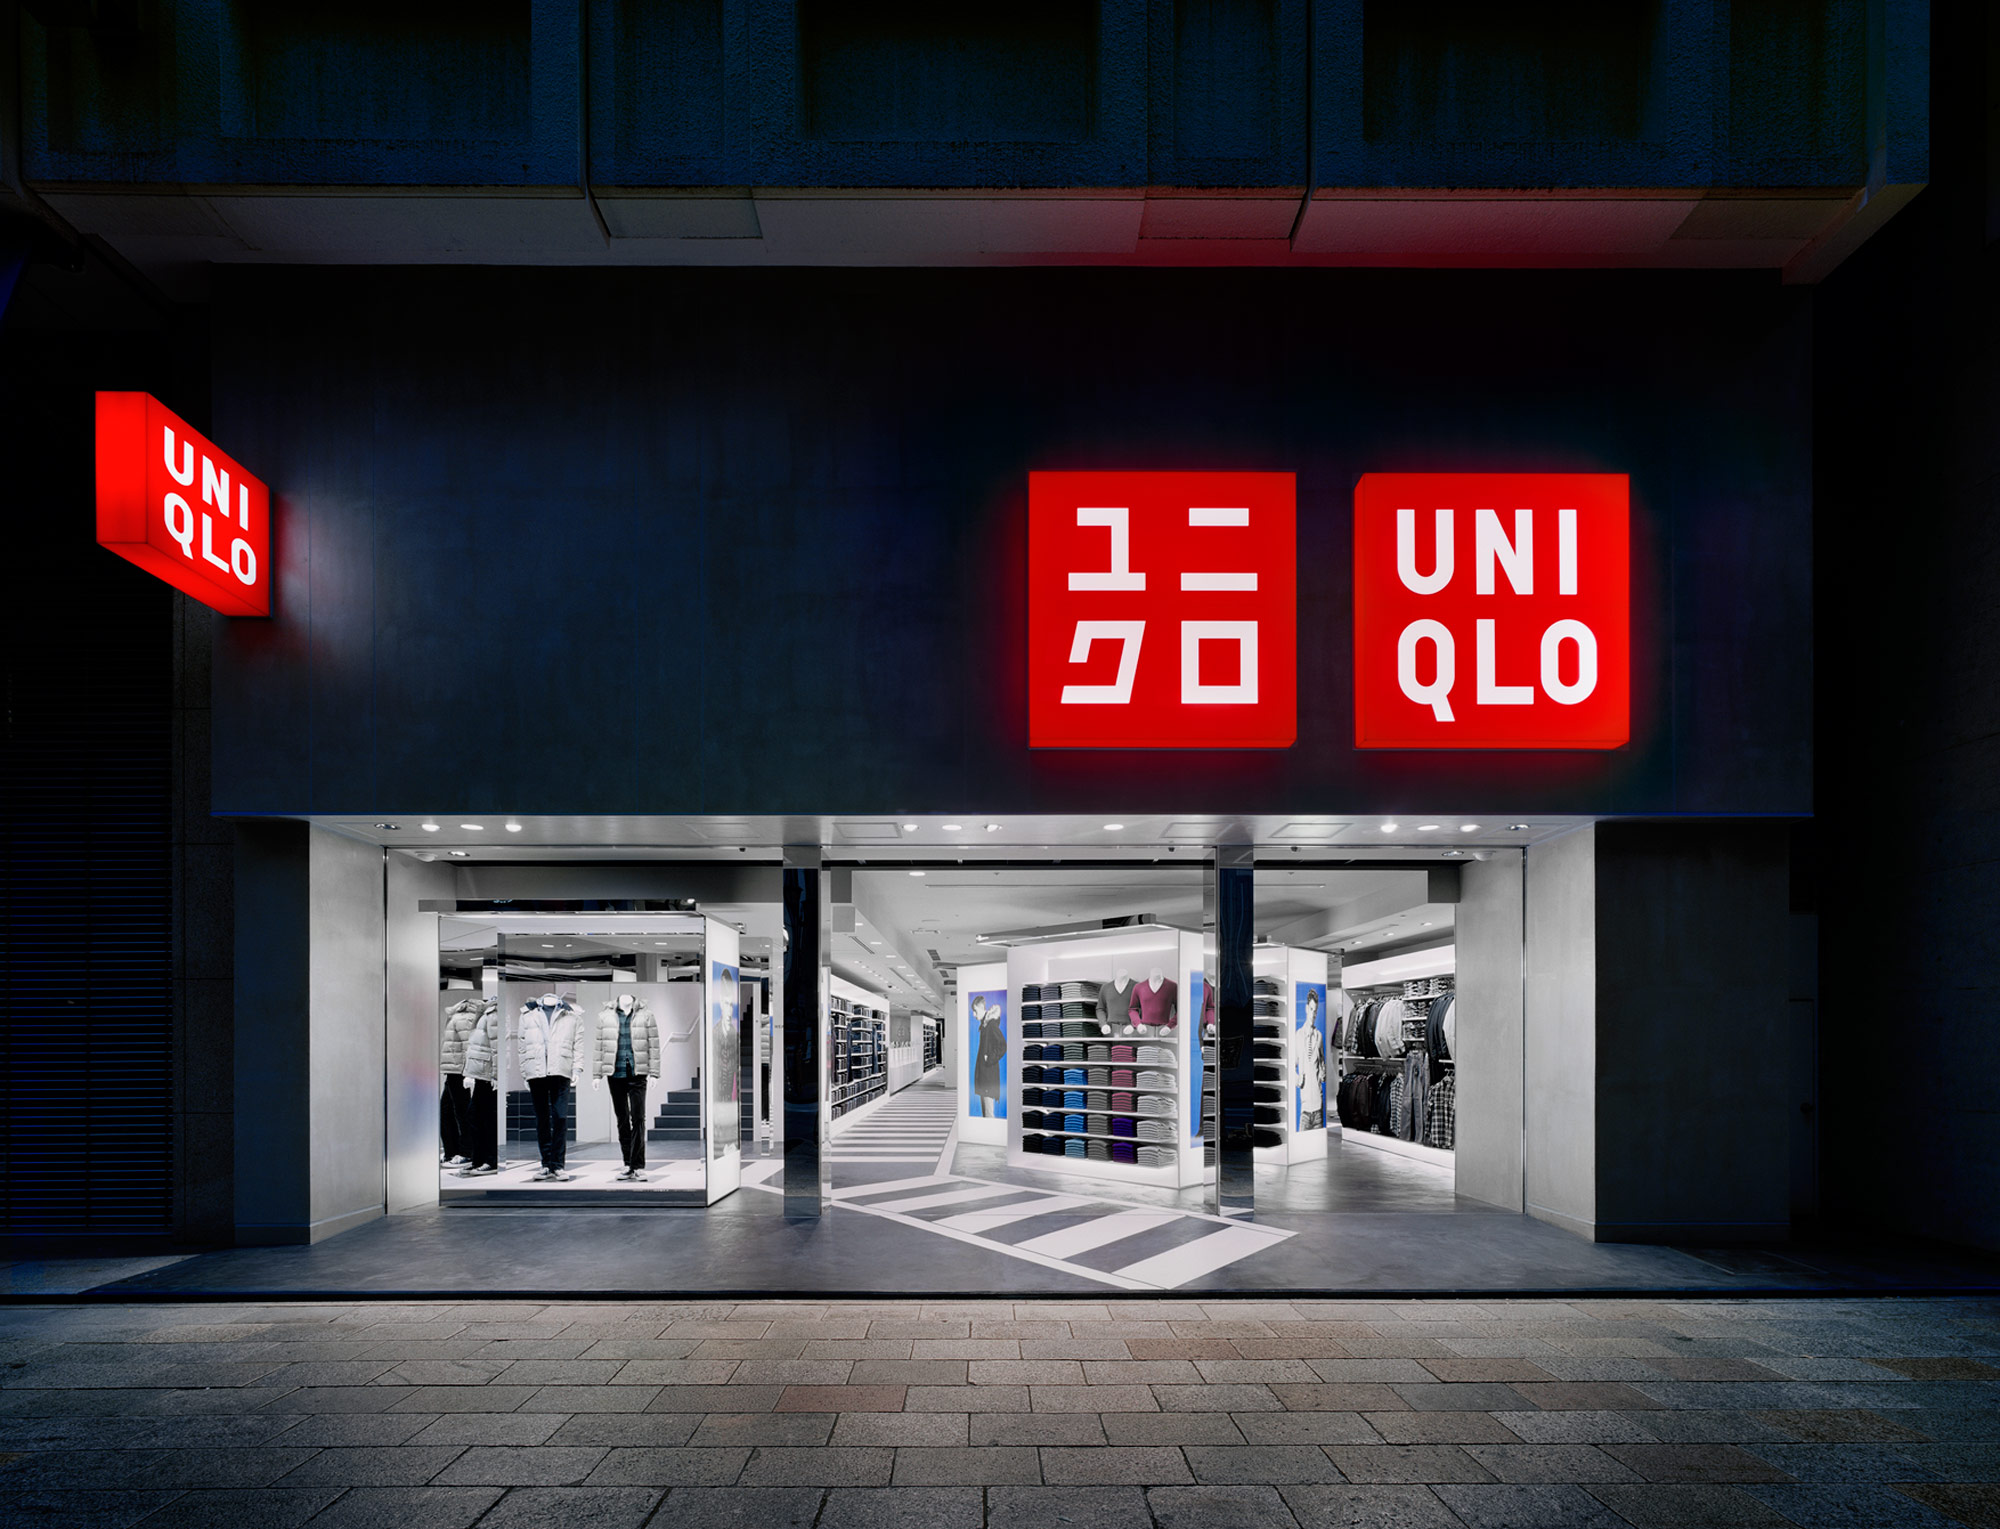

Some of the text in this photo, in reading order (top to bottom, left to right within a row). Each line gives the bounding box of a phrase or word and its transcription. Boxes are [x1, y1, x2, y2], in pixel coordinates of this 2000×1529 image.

[164, 425, 249, 531] UNI
[164, 492, 257, 586] QLO
[1068, 507, 1259, 592] ユニ
[1396, 508, 1578, 595] UNI
[1060, 620, 1259, 704] クロ
[1397, 618, 1598, 722] QLO
